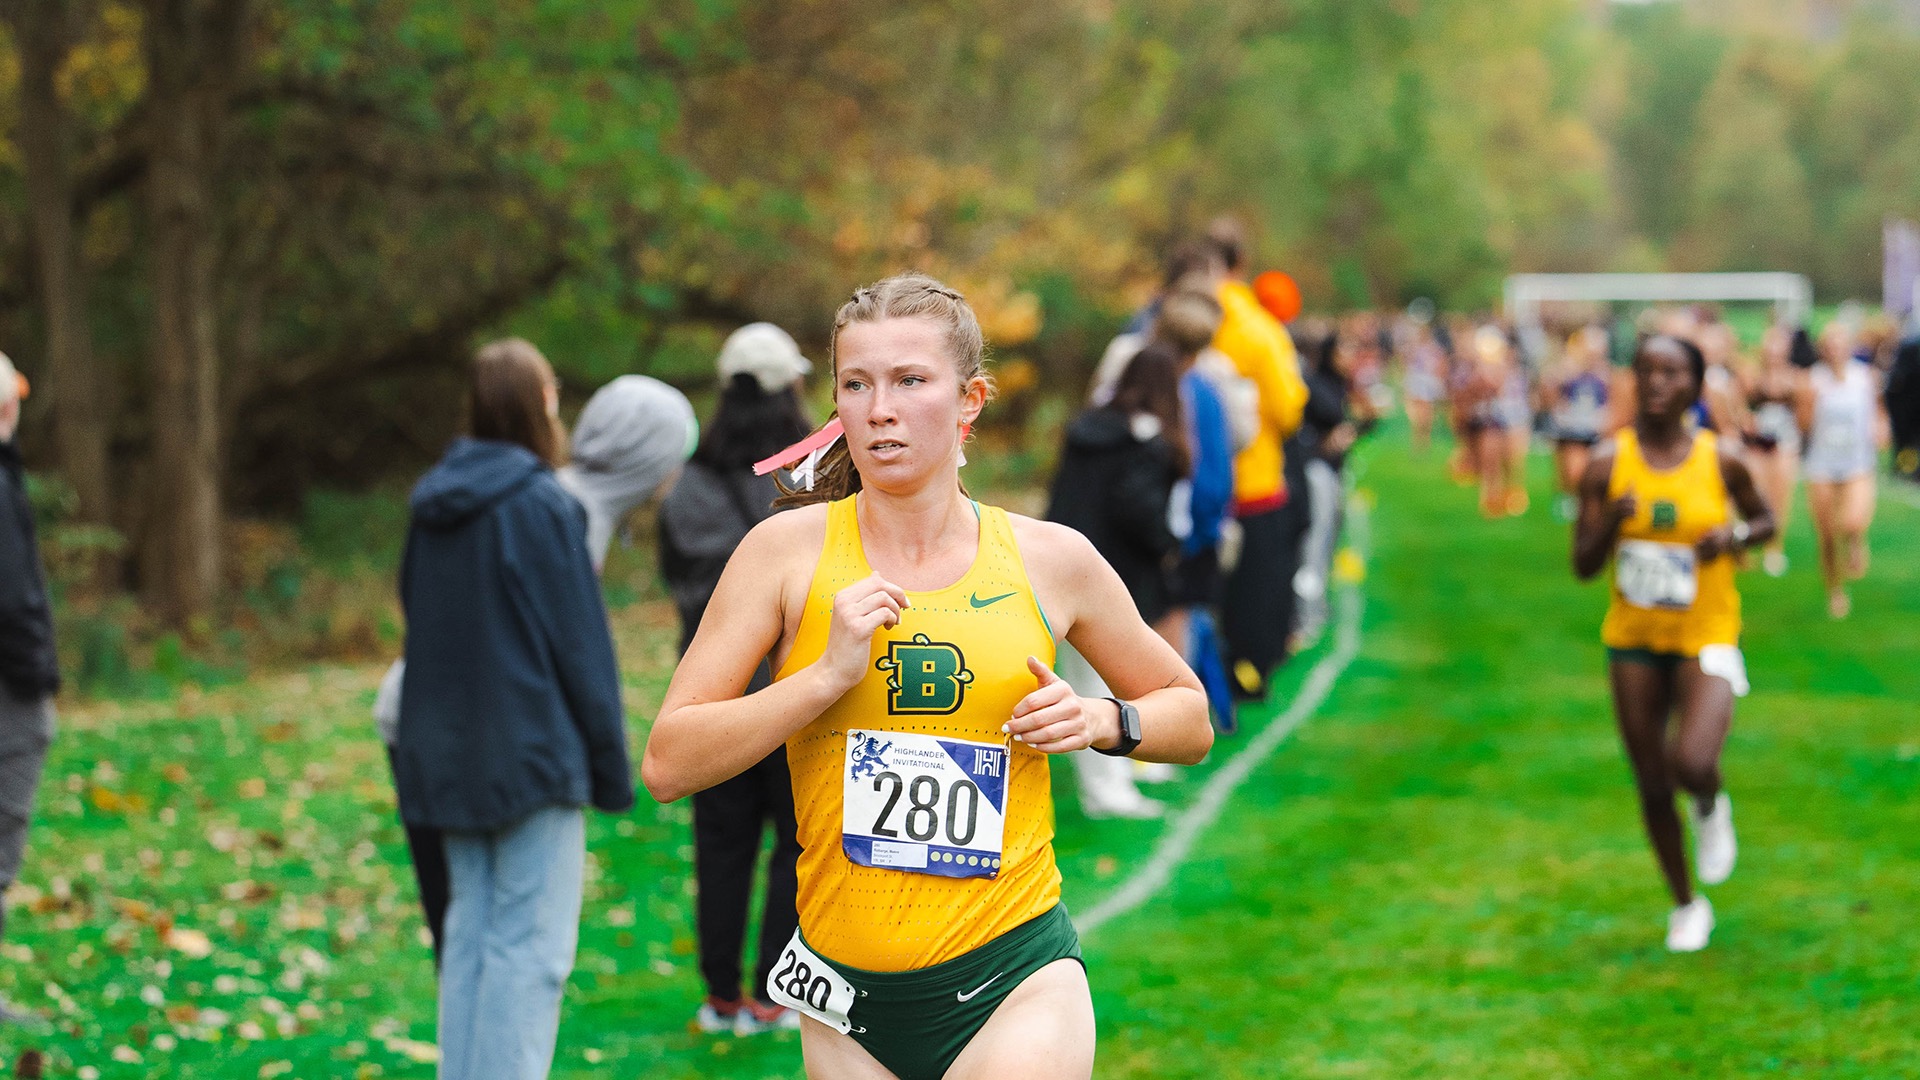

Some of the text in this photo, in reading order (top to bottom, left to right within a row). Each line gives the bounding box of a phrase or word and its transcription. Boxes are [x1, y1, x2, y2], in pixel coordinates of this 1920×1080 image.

[887, 640, 965, 715] B
[892, 758, 945, 770] INVITATIONAL
[894, 747, 945, 759] HIGHLANDER
[871, 771, 979, 846] 280
[774, 949, 832, 1012] 280
